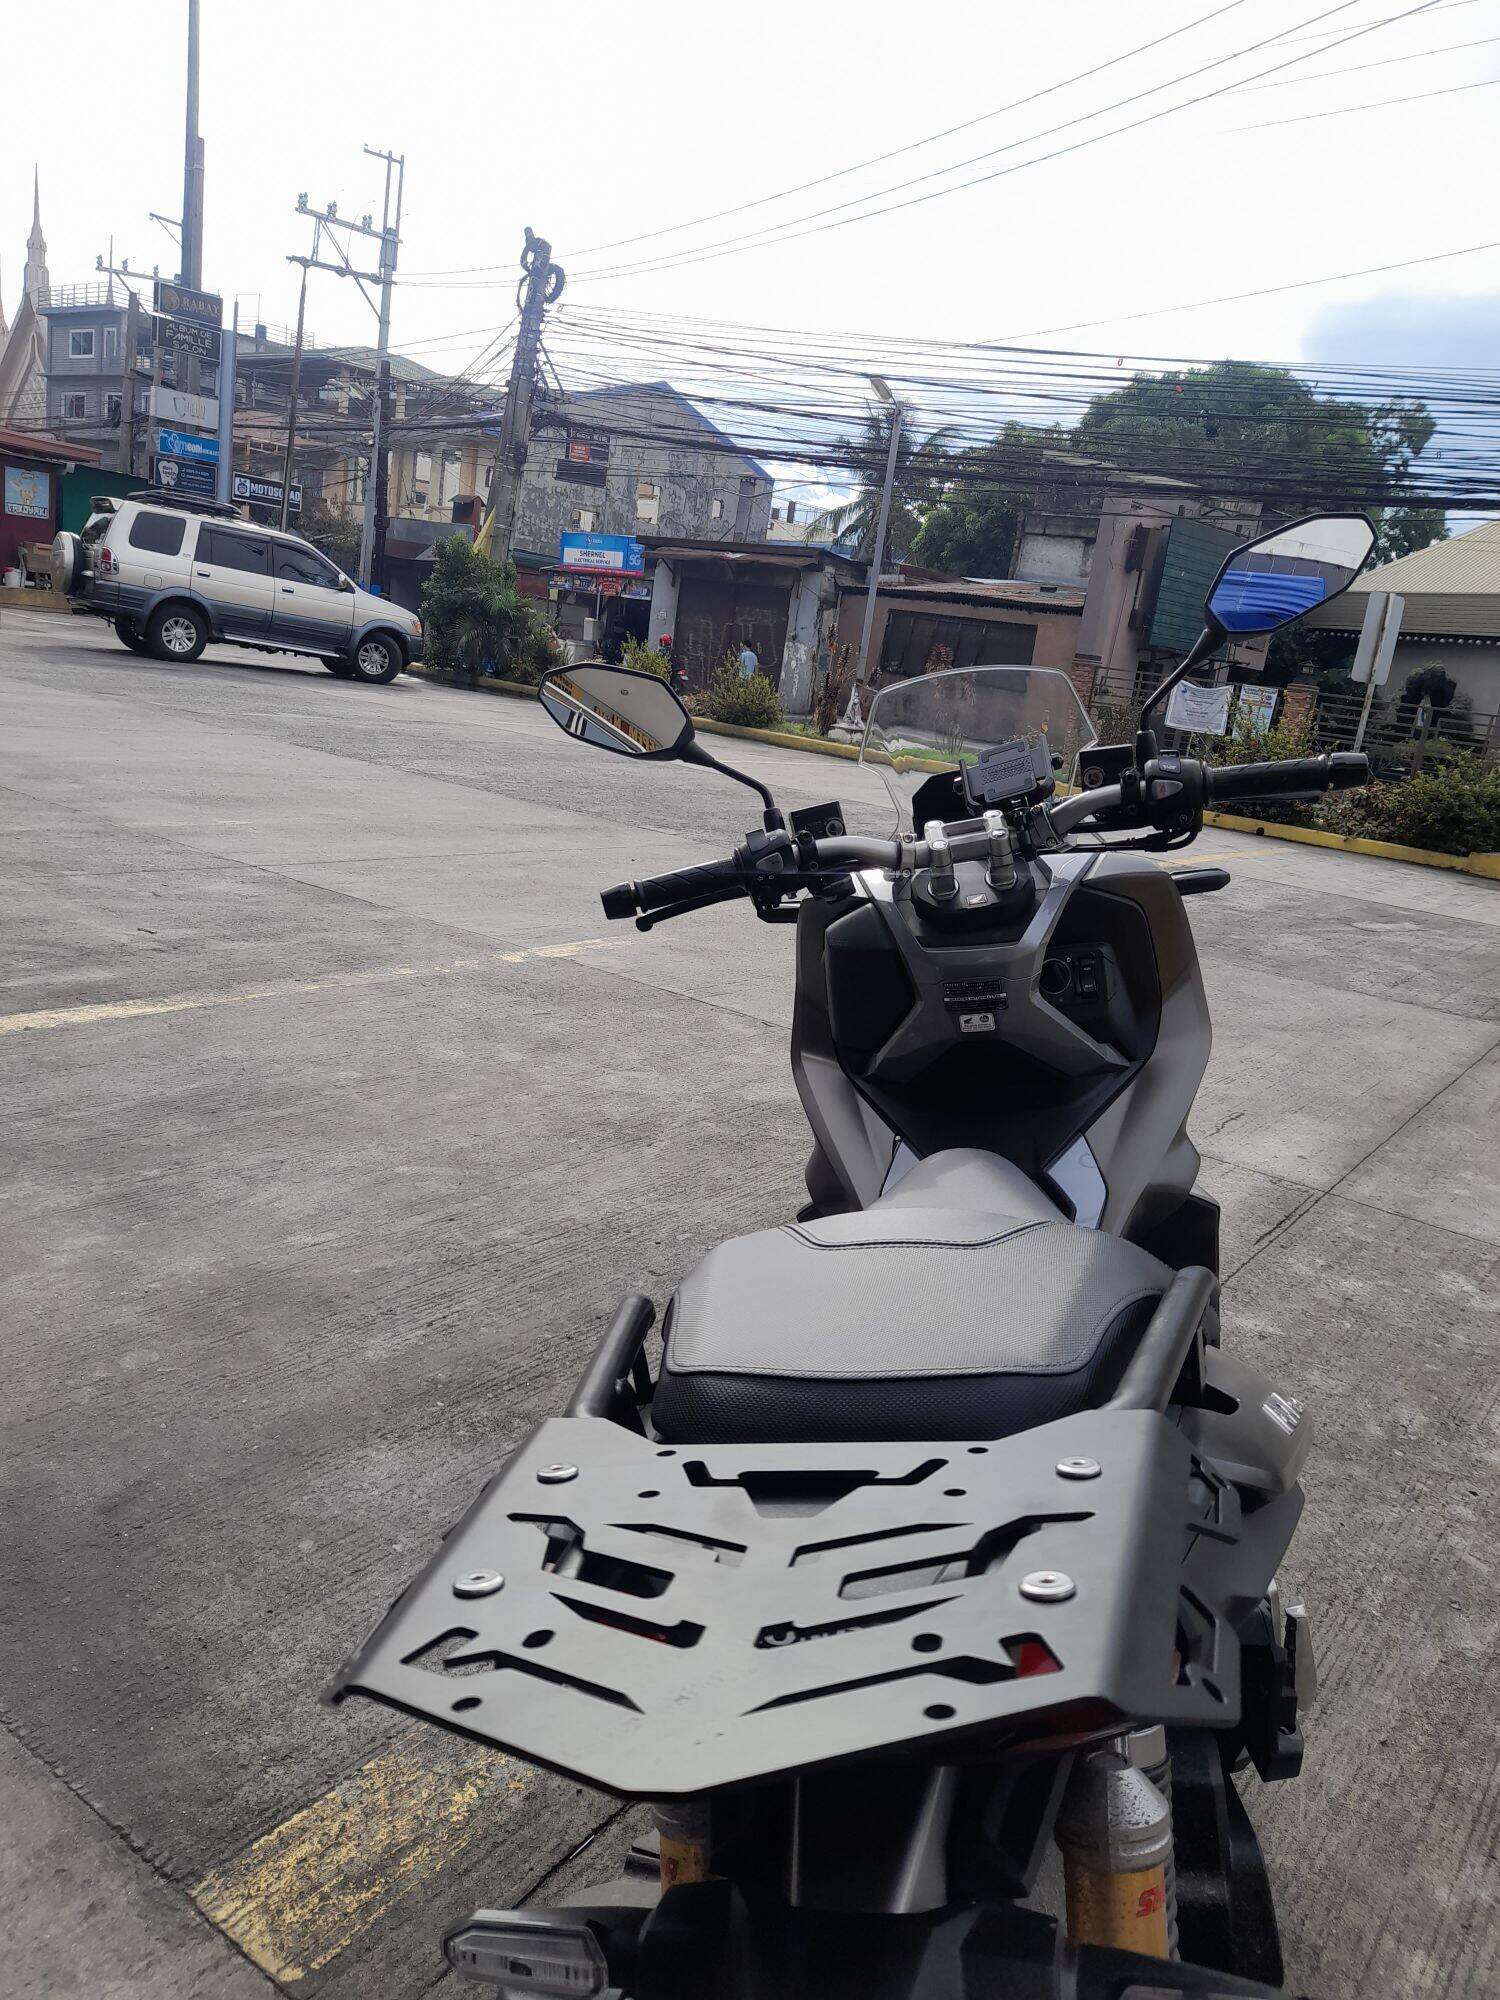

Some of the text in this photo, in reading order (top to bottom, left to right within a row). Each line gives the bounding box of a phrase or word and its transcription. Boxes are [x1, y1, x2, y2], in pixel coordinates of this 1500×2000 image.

[167, 323, 212, 339] ALBUM DE
[166, 330, 213, 349] FAMILLE
[173, 341, 207, 356] SALON
[629, 553, 641, 566] 5G
